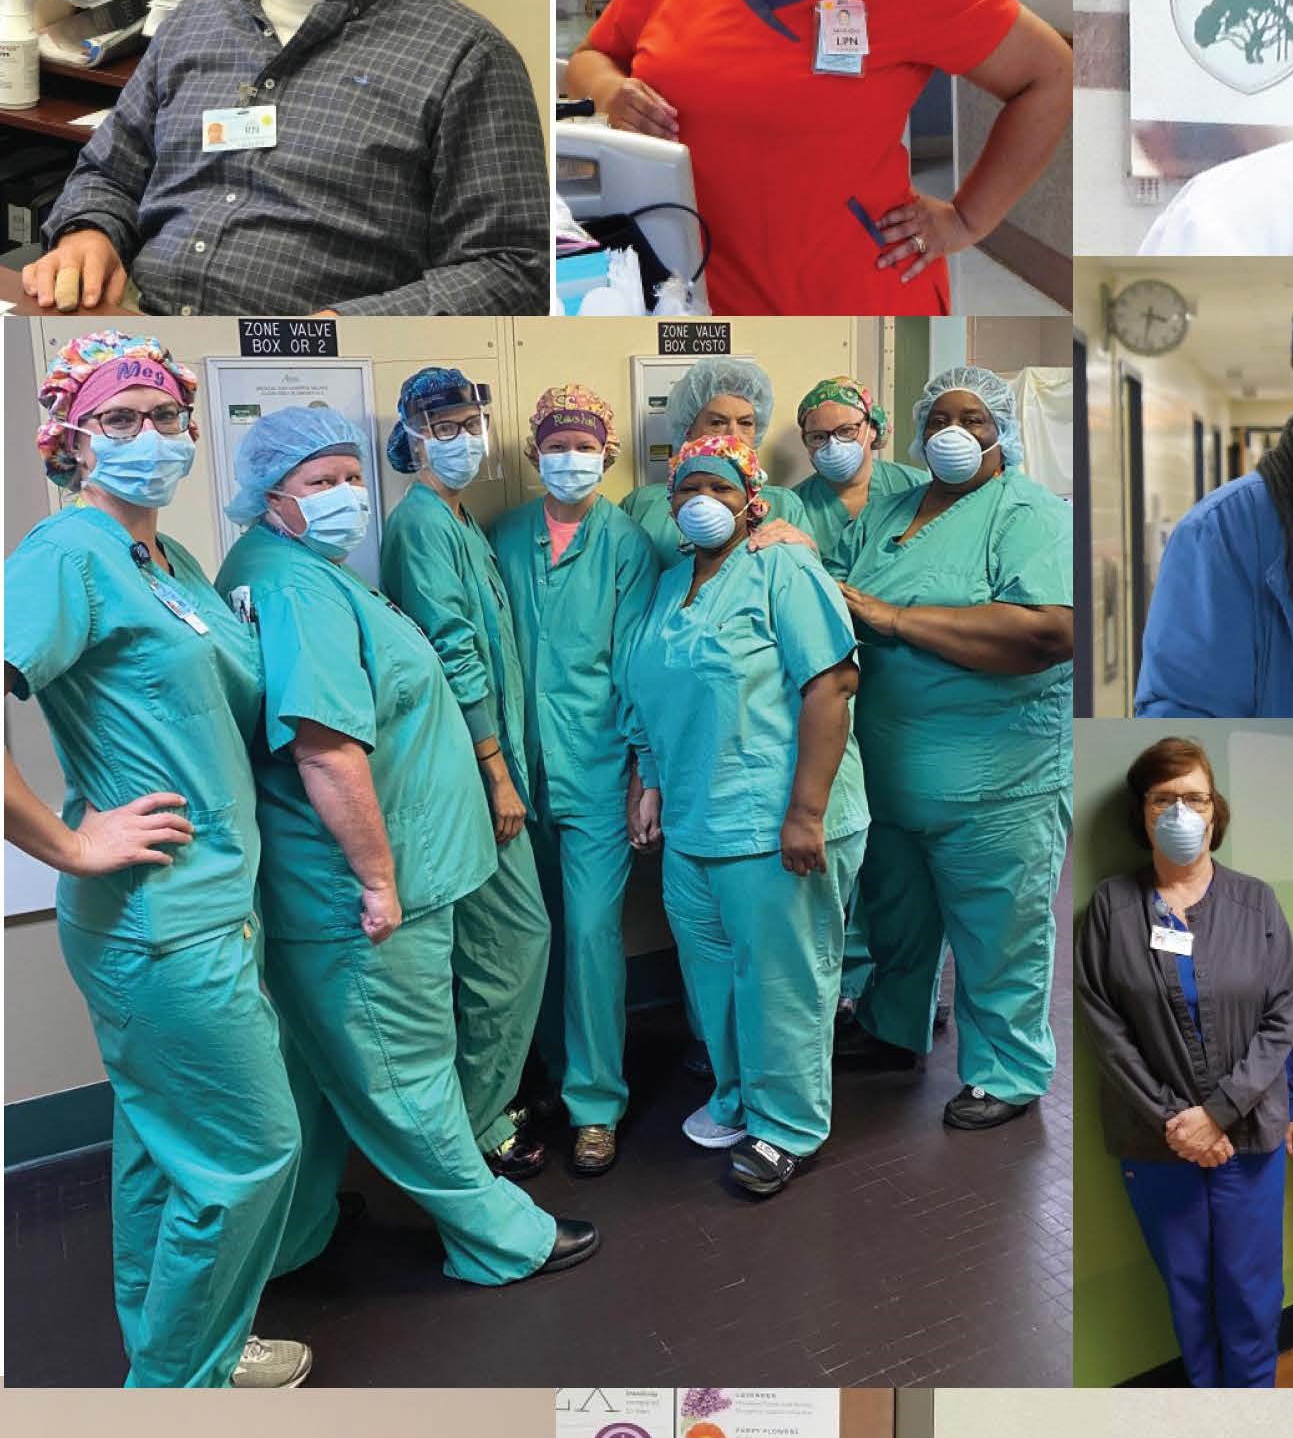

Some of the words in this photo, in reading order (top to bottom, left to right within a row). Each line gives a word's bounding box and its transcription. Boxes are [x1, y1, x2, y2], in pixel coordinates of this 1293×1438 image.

[244, 322, 280, 337] ZONE
[289, 322, 332, 338] VALVE
[662, 325, 689, 338] ZONE
[695, 325, 727, 338] VALVE
[252, 339, 281, 354] BOX
[290, 339, 311, 354] OR
[317, 339, 327, 354] 2
[664, 339, 687, 353] BOX
[692, 339, 726, 353] CYSTO
[117, 361, 165, 386] Meg
